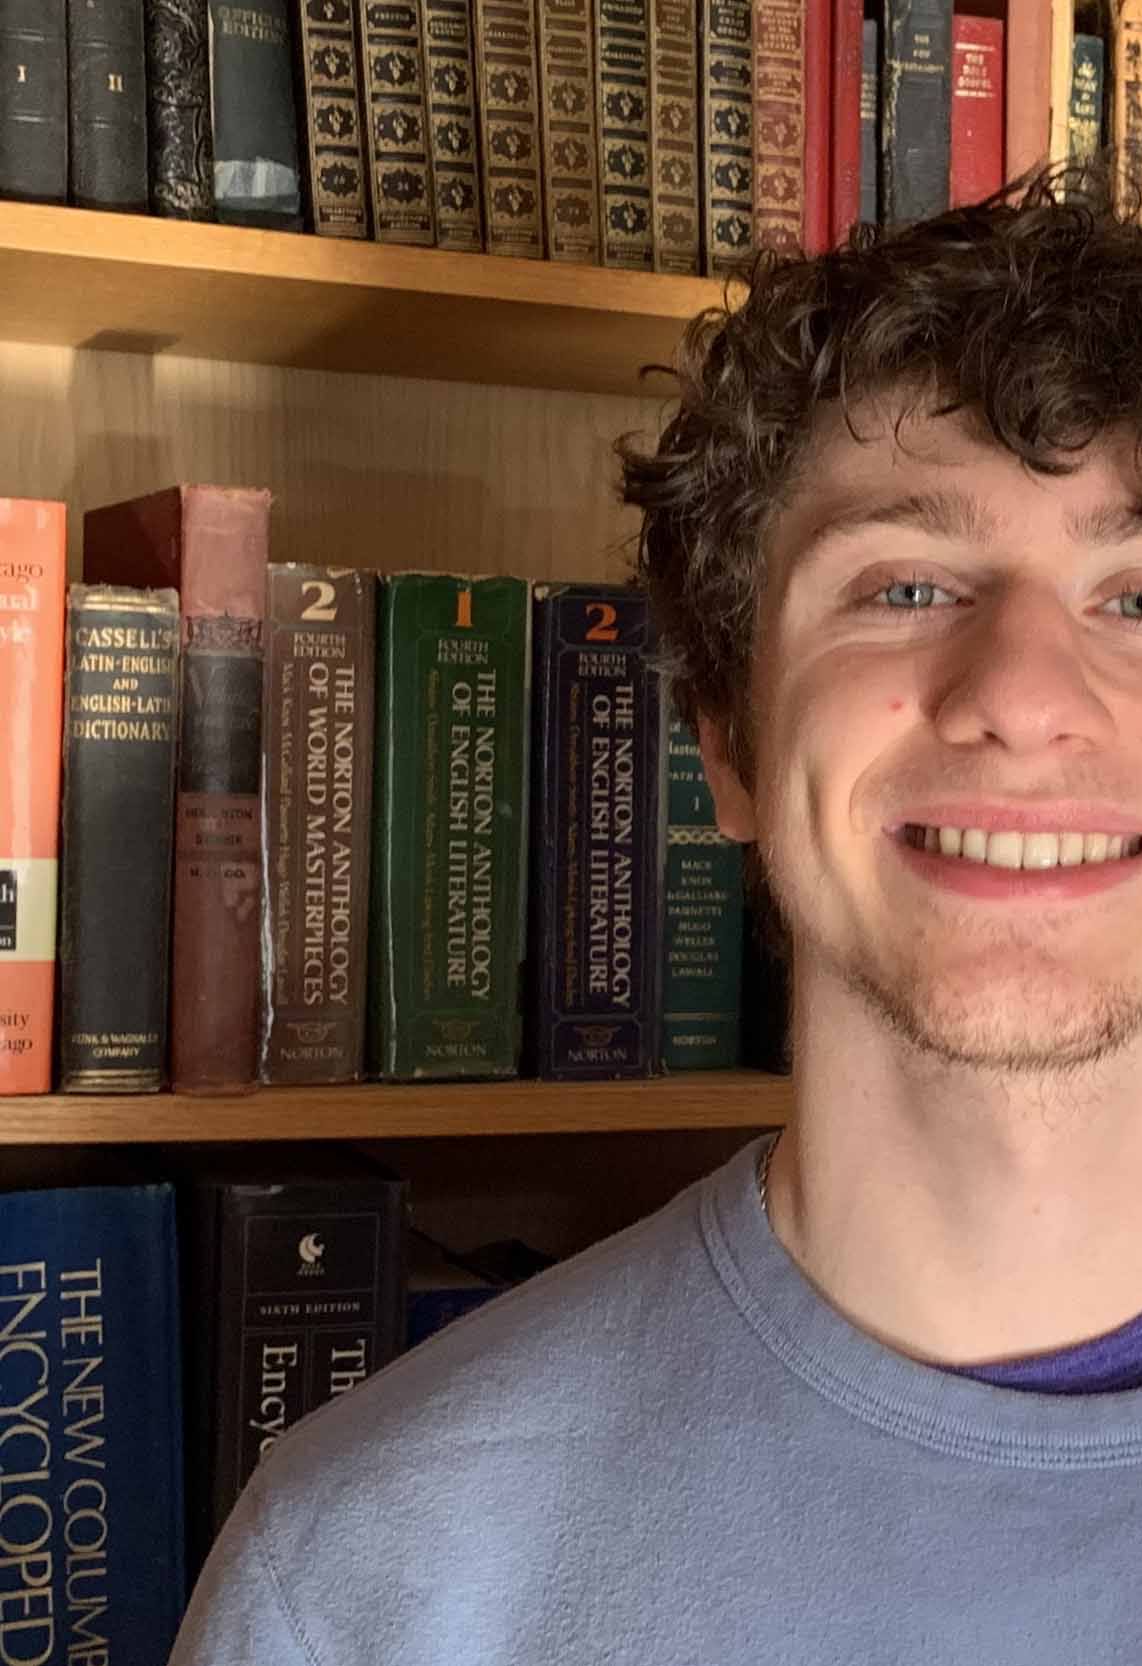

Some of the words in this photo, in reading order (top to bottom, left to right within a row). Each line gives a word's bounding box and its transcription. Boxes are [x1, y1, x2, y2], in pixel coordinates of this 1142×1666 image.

[301, 580, 338, 622] 2
[454, 590, 474, 628] 1
[75, 627, 172, 650] CASSELL'S
[294, 632, 346, 647] FOURTH
[584, 603, 621, 641] 2
[293, 647, 346, 659] EDITION
[437, 639, 489, 652] FOURTH
[437, 652, 489, 664] EDITION
[578, 652, 627, 665] FOURTH
[112, 678, 139, 691] AND
[308, 661, 329, 699] OF
[334, 663, 355, 712] THE
[578, 665, 627, 677] EDITION
[451, 681, 472, 719] OF
[475, 668, 497, 719] THE
[591, 693, 611, 730] OF
[614, 681, 634, 730] THE
[73, 720, 169, 741] DICTIONARY
[305, 706, 328, 805] WORLD
[332, 721, 354, 833] NORTON
[448, 725, 470, 831] ENGLISH
[472, 727, 494, 835] NORTON
[590, 735, 610, 842] ENGLISH
[613, 736, 633, 845] NORTON
[303, 815, 326, 1006] MASTERPIECES
[329, 842, 352, 1005] ANTHOLOGY
[446, 839, 468, 988] LITERATURE
[470, 842, 493, 1001] ANTHOLOGY
[588, 849, 609, 994] LITERATURE
[611, 851, 632, 1009] ANTHOLOGY
[280, 1046, 343, 1059] NORTON
[425, 1043, 487, 1058] NORTON
[567, 1047, 628, 1063] NORTON
[60, 1257, 104, 1349] THE
[259, 1303, 301, 1316] SIXTH
[305, 1301, 361, 1314] EDITION
[62, 1355, 106, 1469] NEW
